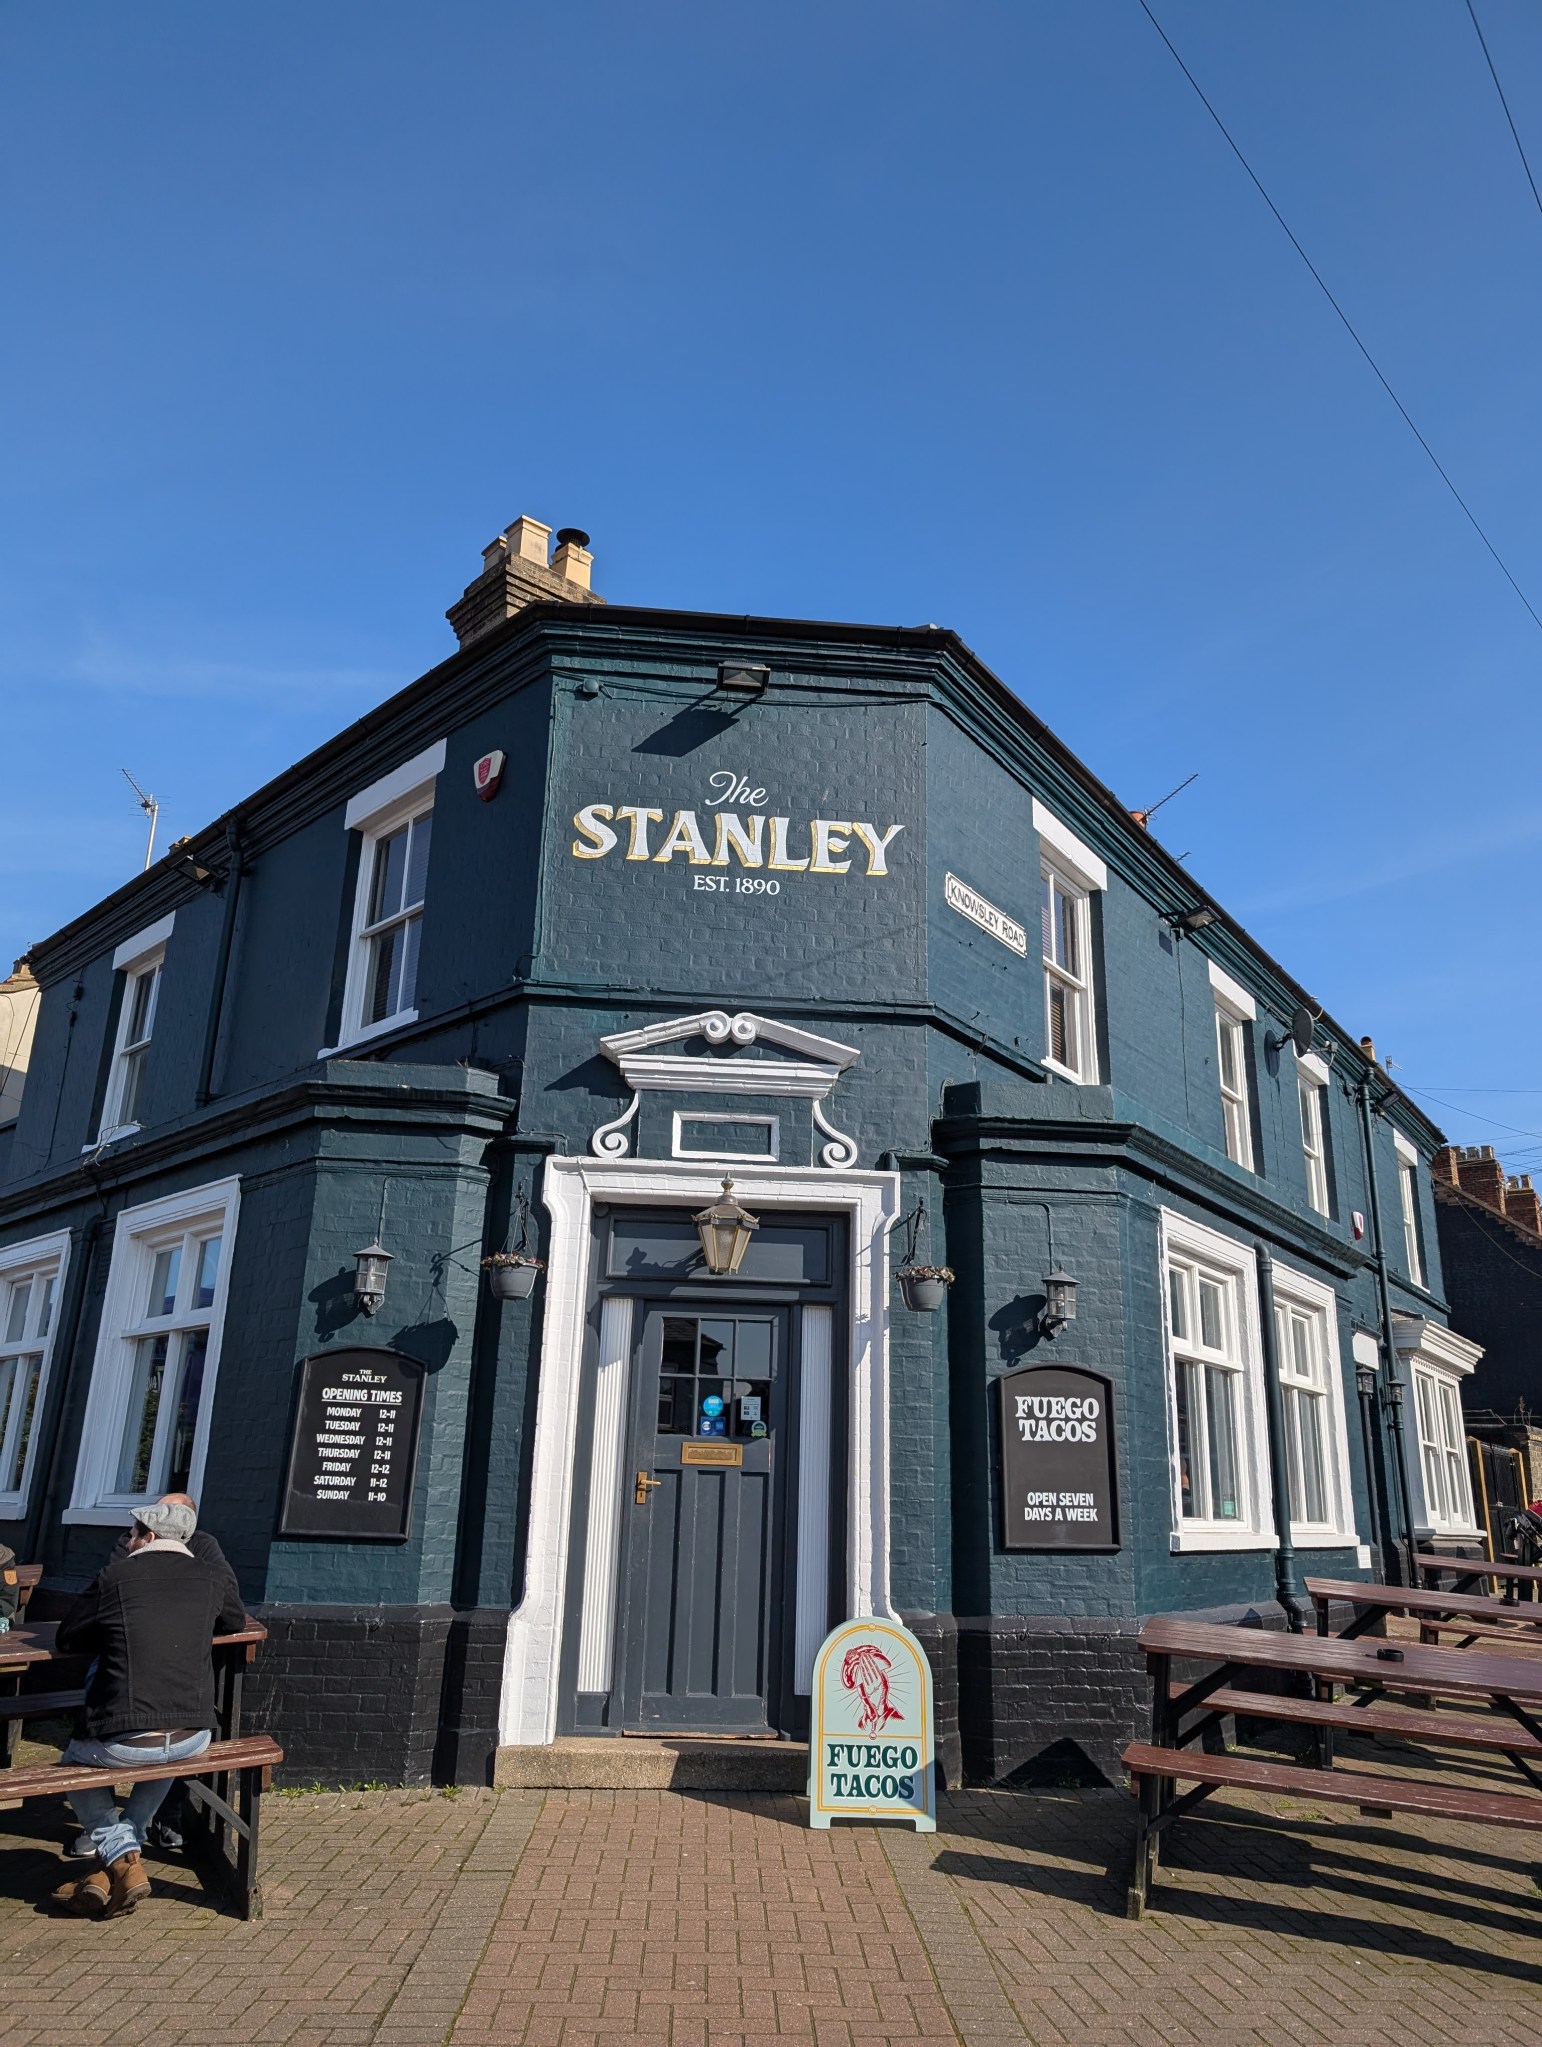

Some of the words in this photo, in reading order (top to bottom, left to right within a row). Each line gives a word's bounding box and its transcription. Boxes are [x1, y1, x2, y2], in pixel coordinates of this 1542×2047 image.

[705, 771, 769, 806] The
[572, 803, 905, 876] STANLEY
[693, 874, 730, 892] EST.
[735, 877, 780, 895] 1890
[951, 882, 999, 930] KNOWSLEY
[1002, 920, 1024, 947] ROAD
[341, 1373, 388, 1383] STANLEY
[322, 1387, 368, 1401] OPENING
[370, 1390, 402, 1403] TIMES
[326, 1406, 362, 1417] MONDAY
[1014, 1396, 1100, 1419] FUEGO
[325, 1420, 361, 1431] TUESDAY
[1018, 1419, 1097, 1442] TACOS
[316, 1434, 365, 1445] WEDNESDAY
[318, 1448, 360, 1459] THURSDAY
[322, 1461, 351, 1472] FRIDAY
[313, 1475, 356, 1487] SATURDAY
[316, 1489, 350, 1500] SUNDAY
[1027, 1492, 1057, 1506] OPEN
[1059, 1492, 1094, 1506] SEVEN
[1024, 1508, 1053, 1521] DAYS
[1055, 1508, 1063, 1521] A
[1066, 1508, 1098, 1521] WEEK
[826, 1743, 918, 1770] FUEGO
[830, 1773, 915, 1800] TACOS
